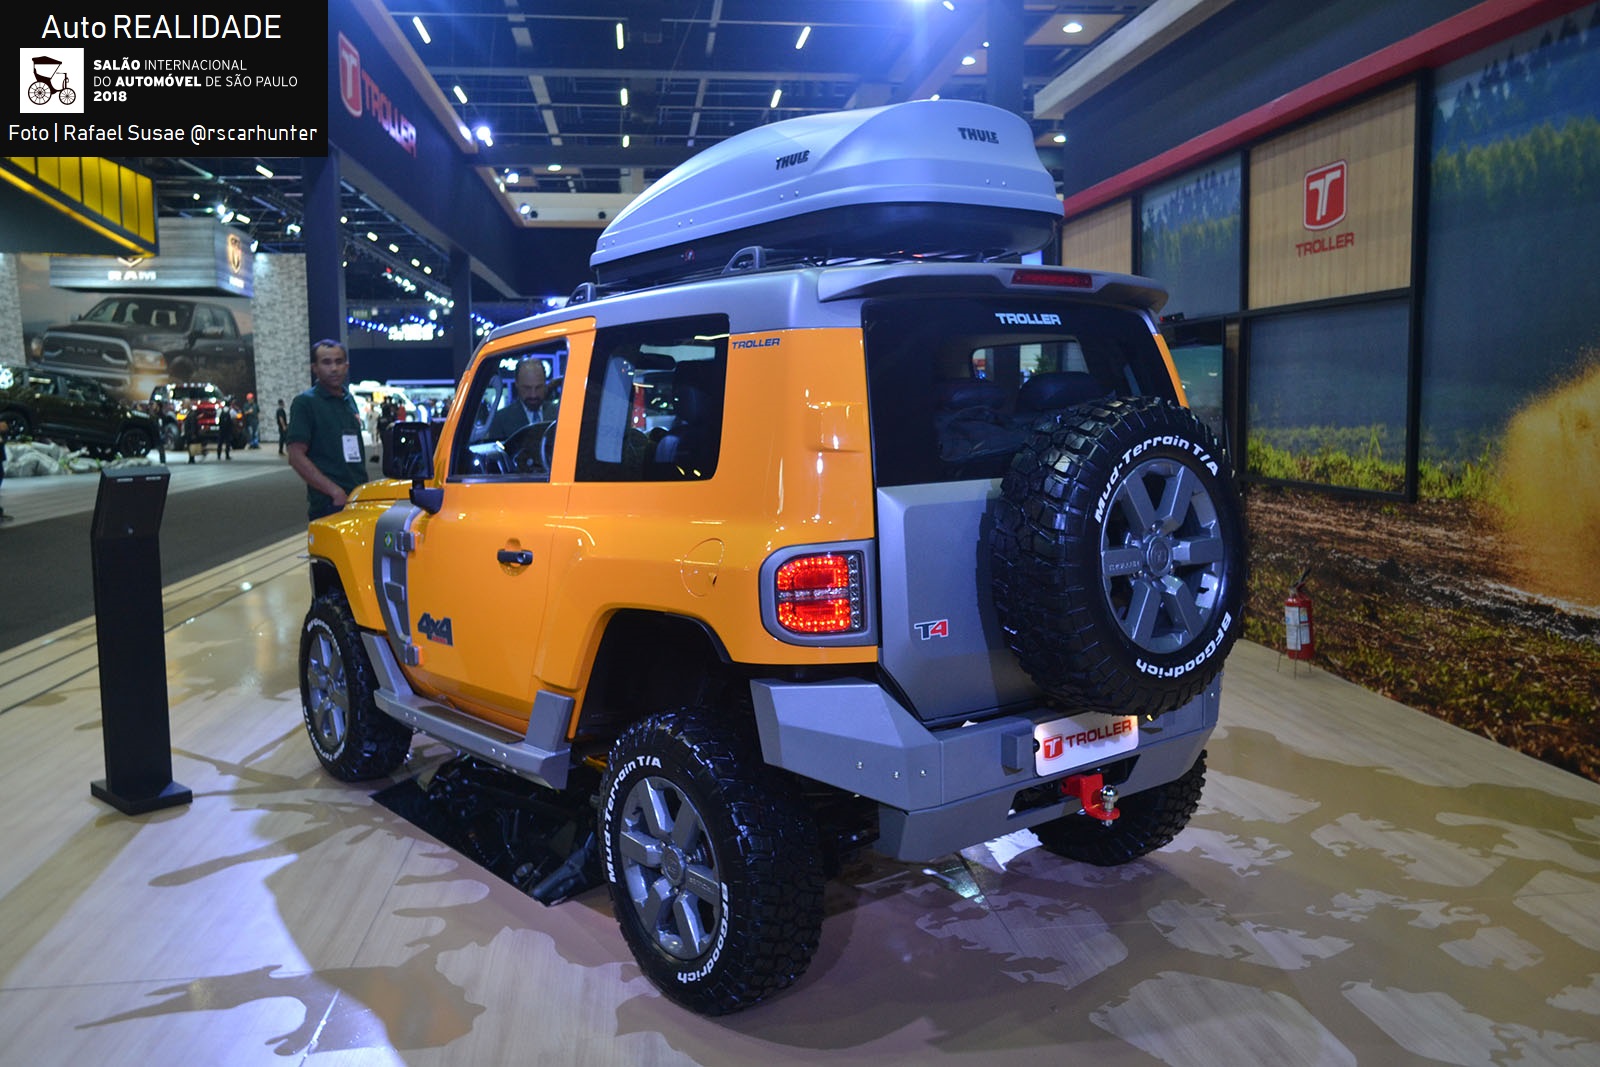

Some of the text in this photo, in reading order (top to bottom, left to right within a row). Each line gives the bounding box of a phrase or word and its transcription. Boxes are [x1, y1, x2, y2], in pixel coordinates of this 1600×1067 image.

[361, 69, 416, 157] TROLLER
[958, 127, 999, 144] THULE
[776, 149, 810, 170] THULE
[1295, 232, 1354, 257] TROLLER
[107, 271, 156, 281] RAM
[994, 313, 1062, 325] TROLLER
[732, 338, 780, 349] TROLLER
[1094, 435, 1219, 524] Mud-Terrain T/A
[914, 619, 948, 640] T4
[1135, 611, 1233, 679] BFGoodrich
[1066, 719, 1132, 748] TROLLER
[603, 755, 662, 883] Mud-Terrain T/A
[677, 881, 729, 984] BFGoodrich
